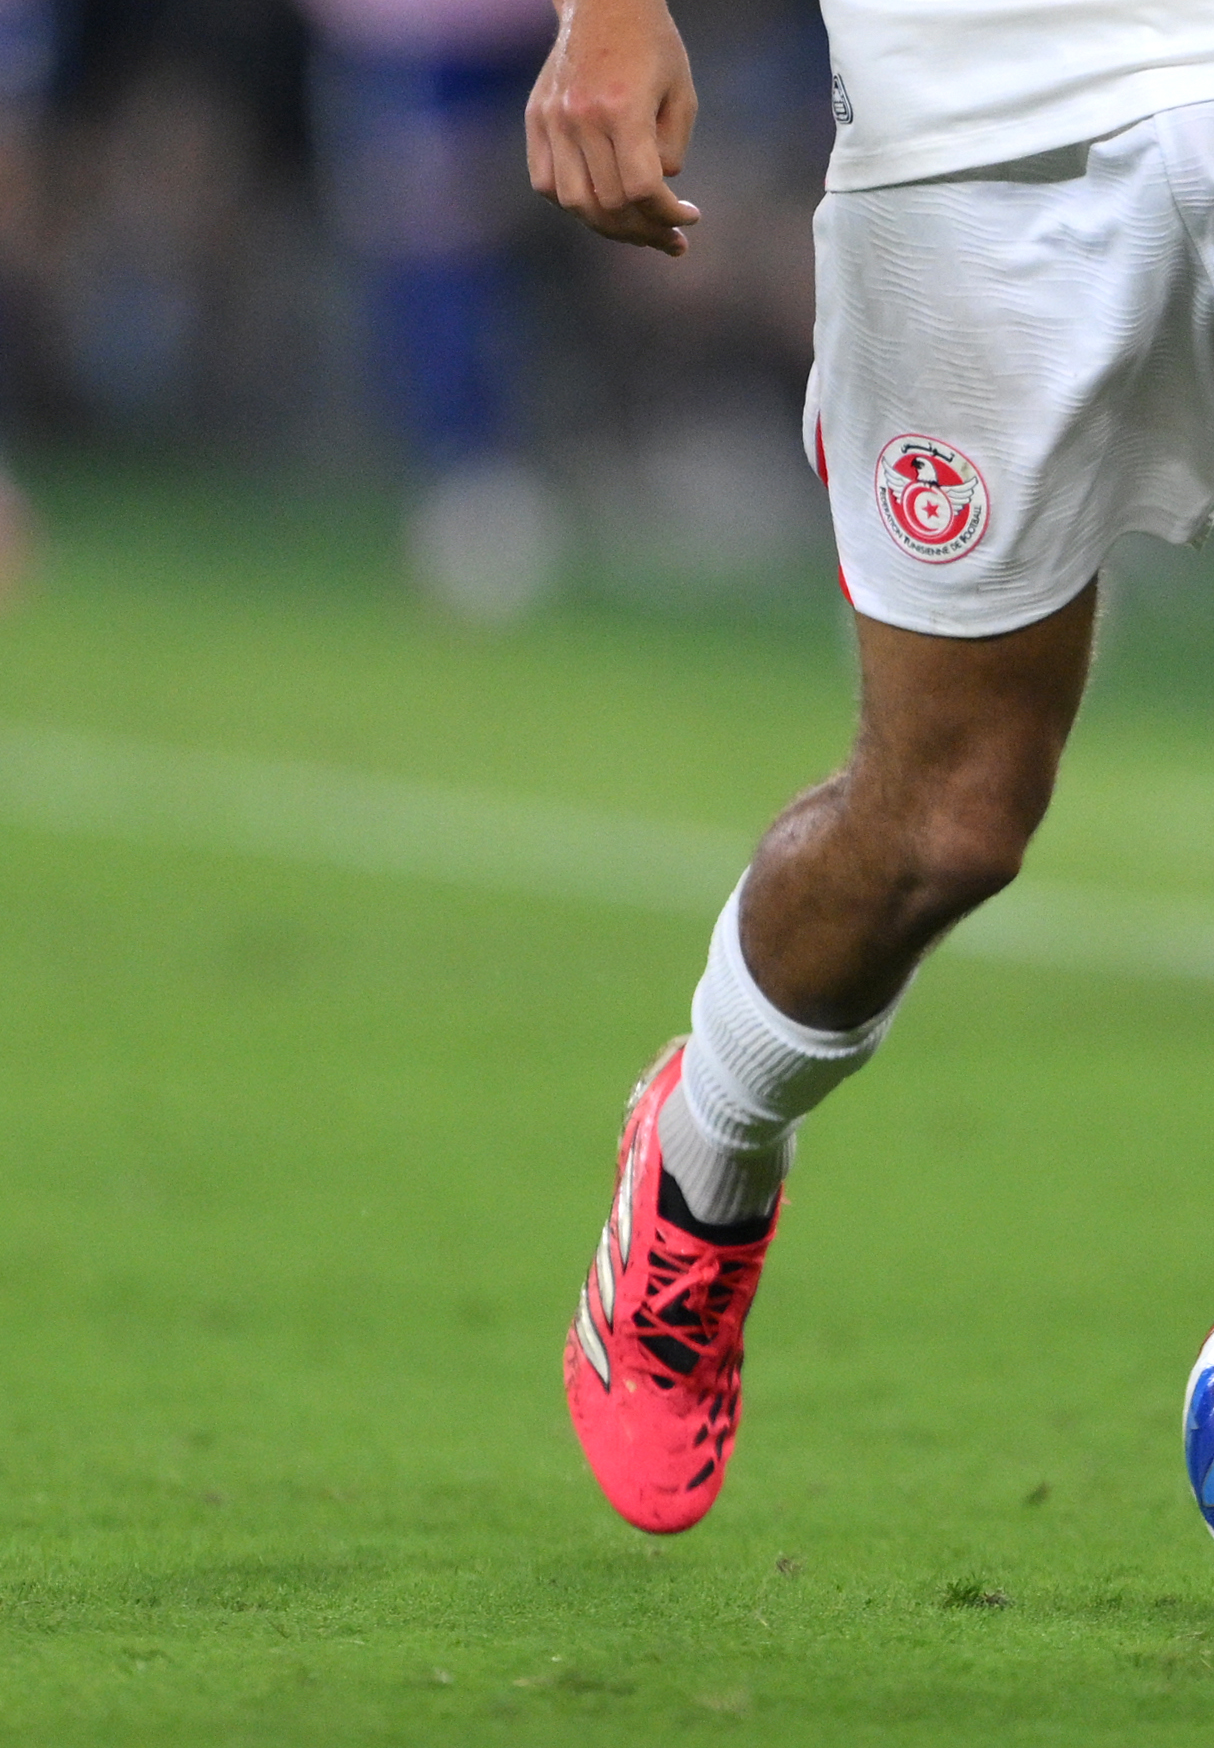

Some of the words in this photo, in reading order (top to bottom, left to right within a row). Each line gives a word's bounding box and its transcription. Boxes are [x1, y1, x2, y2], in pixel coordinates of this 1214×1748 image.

[903, 536, 950, 557] TUNISIENNE
[951, 540, 962, 551] DE
[960, 504, 983, 545] FOOTBALL
